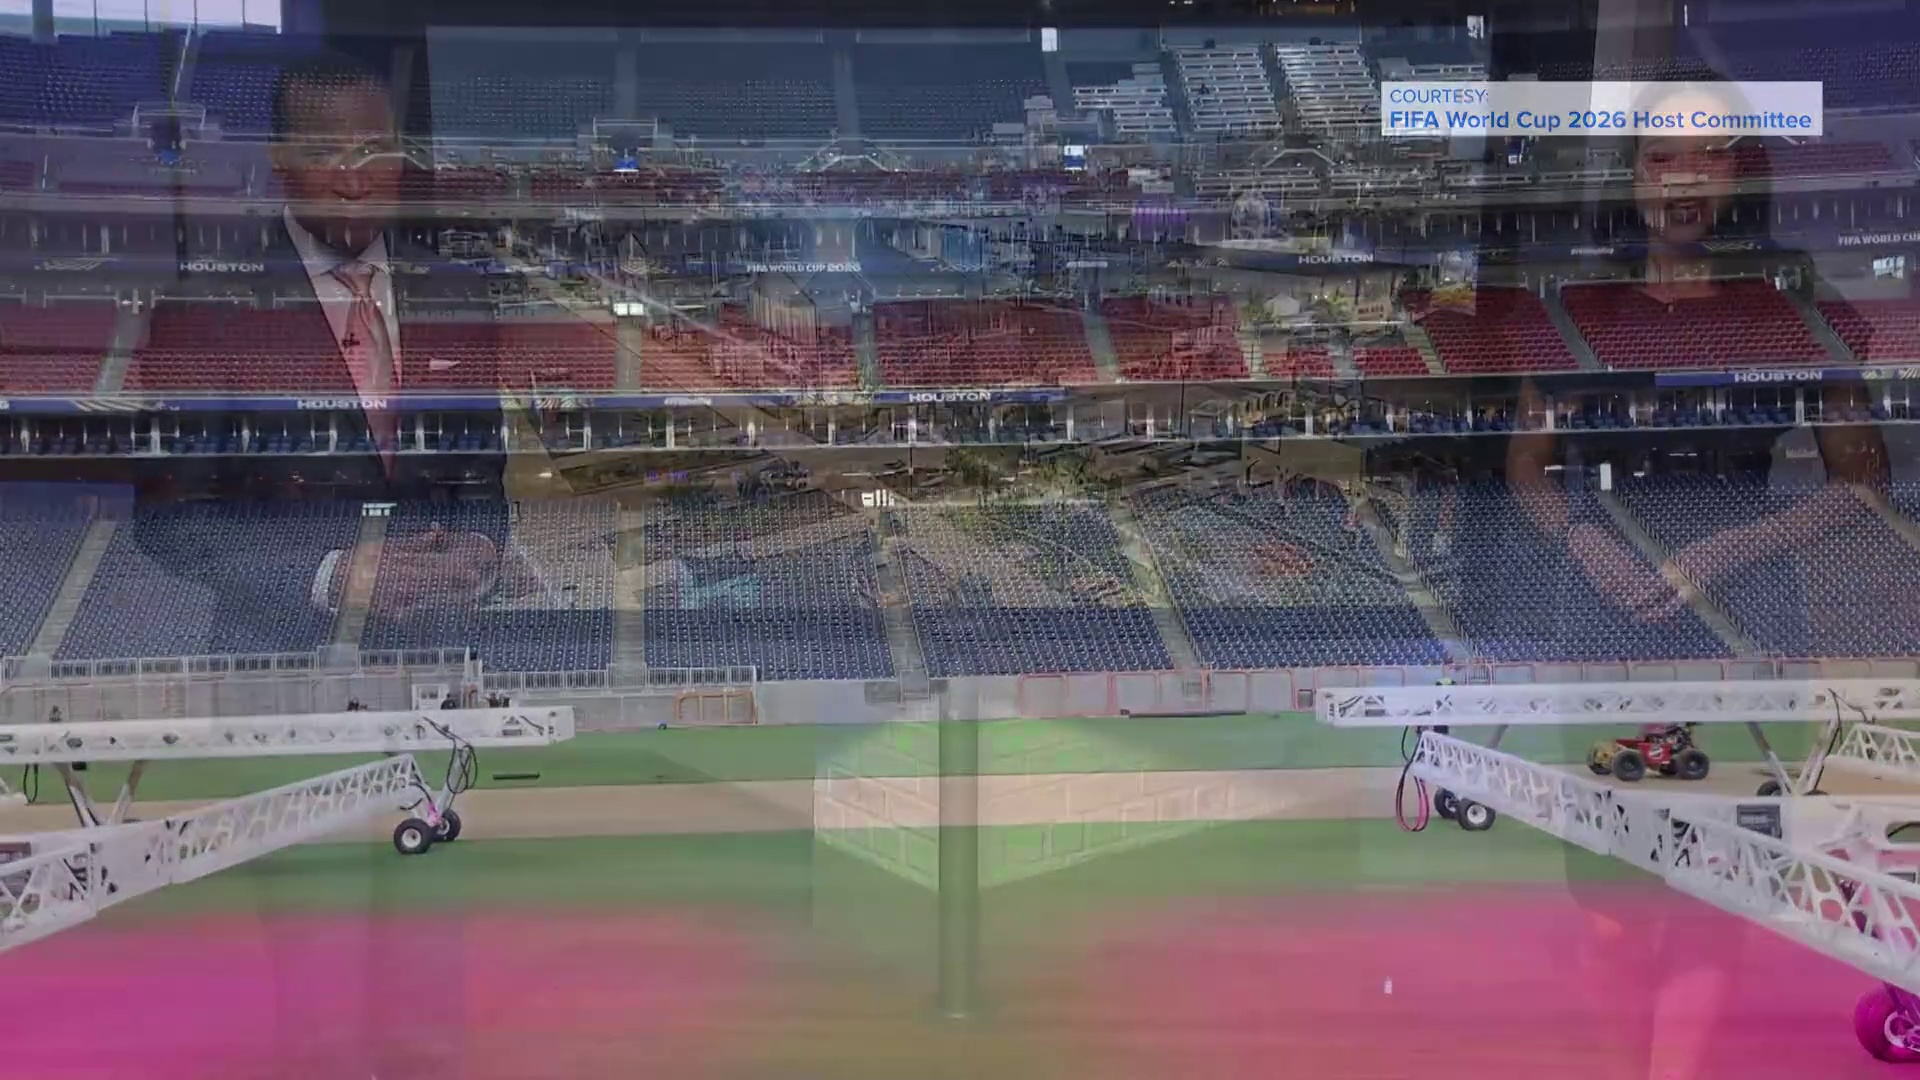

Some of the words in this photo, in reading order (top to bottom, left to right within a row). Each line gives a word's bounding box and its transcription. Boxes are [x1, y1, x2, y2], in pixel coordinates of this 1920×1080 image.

[1838, 235, 1862, 246] FIFA
[1862, 233, 1902, 244] WORLD
[1298, 253, 1374, 265] HOUSTON
[179, 261, 265, 272] HOUSTON
[746, 263, 769, 273] FIFA
[769, 263, 805, 273] WORLD
[806, 263, 826, 273] CUP
[1734, 370, 1823, 383] HOUSTON
[908, 391, 991, 403] HOUSTON
[296, 398, 387, 410] HOUSTON
